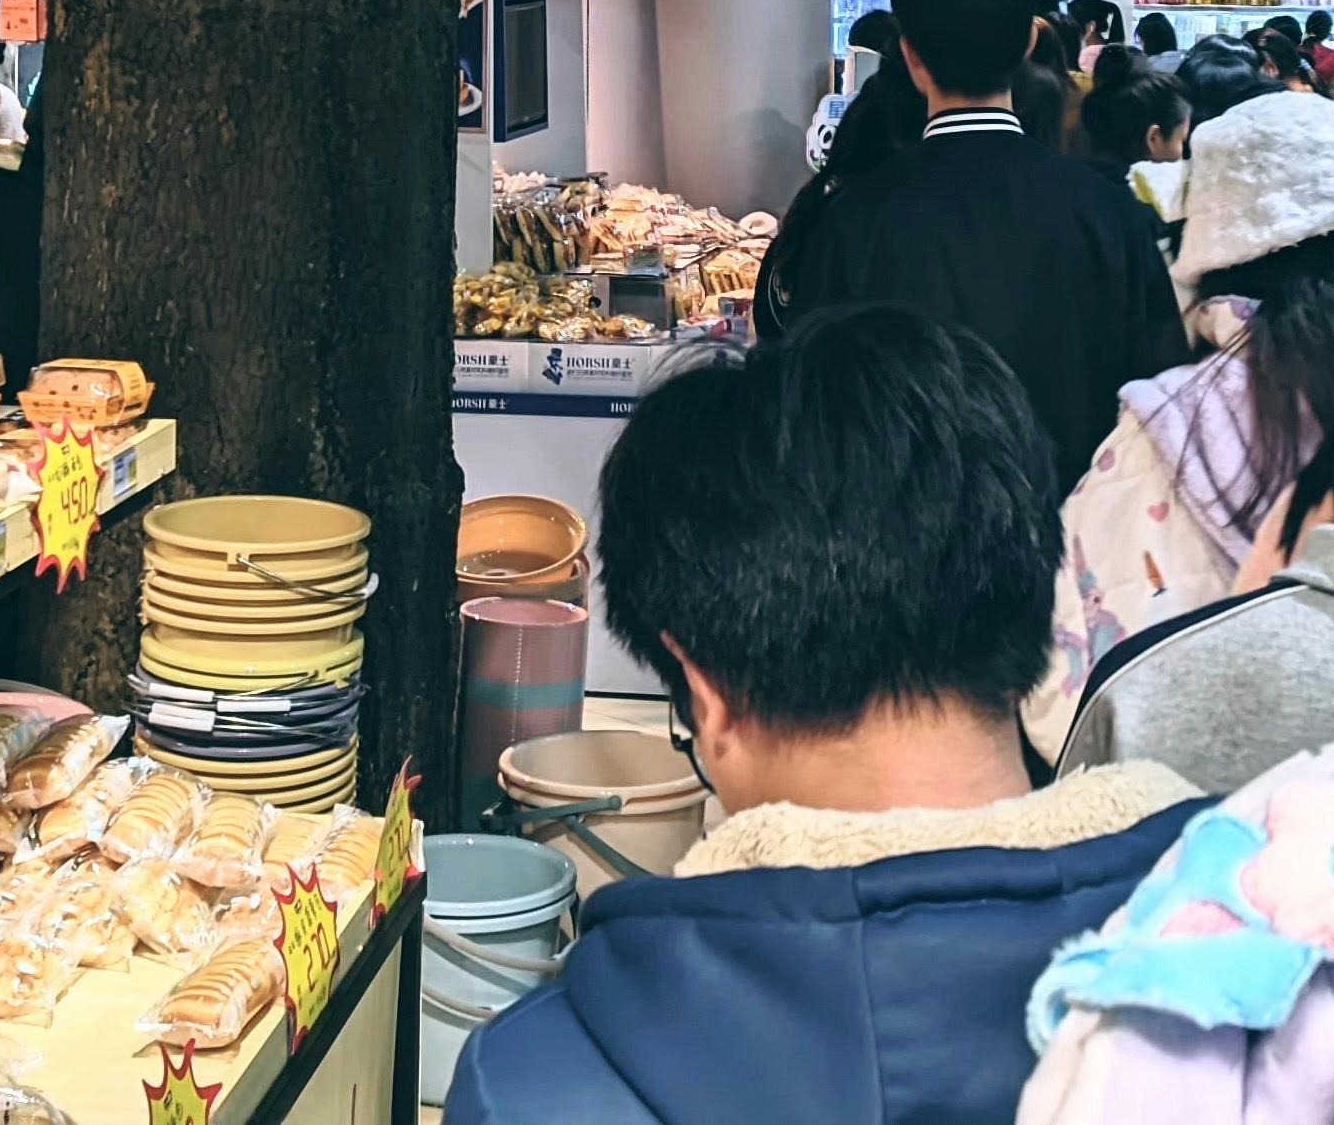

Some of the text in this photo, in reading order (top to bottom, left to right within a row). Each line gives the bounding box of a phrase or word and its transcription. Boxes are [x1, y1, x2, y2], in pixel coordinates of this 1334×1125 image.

[489, 355, 510, 367] 豪士
[566, 357, 633, 369] HORSH 豪士
